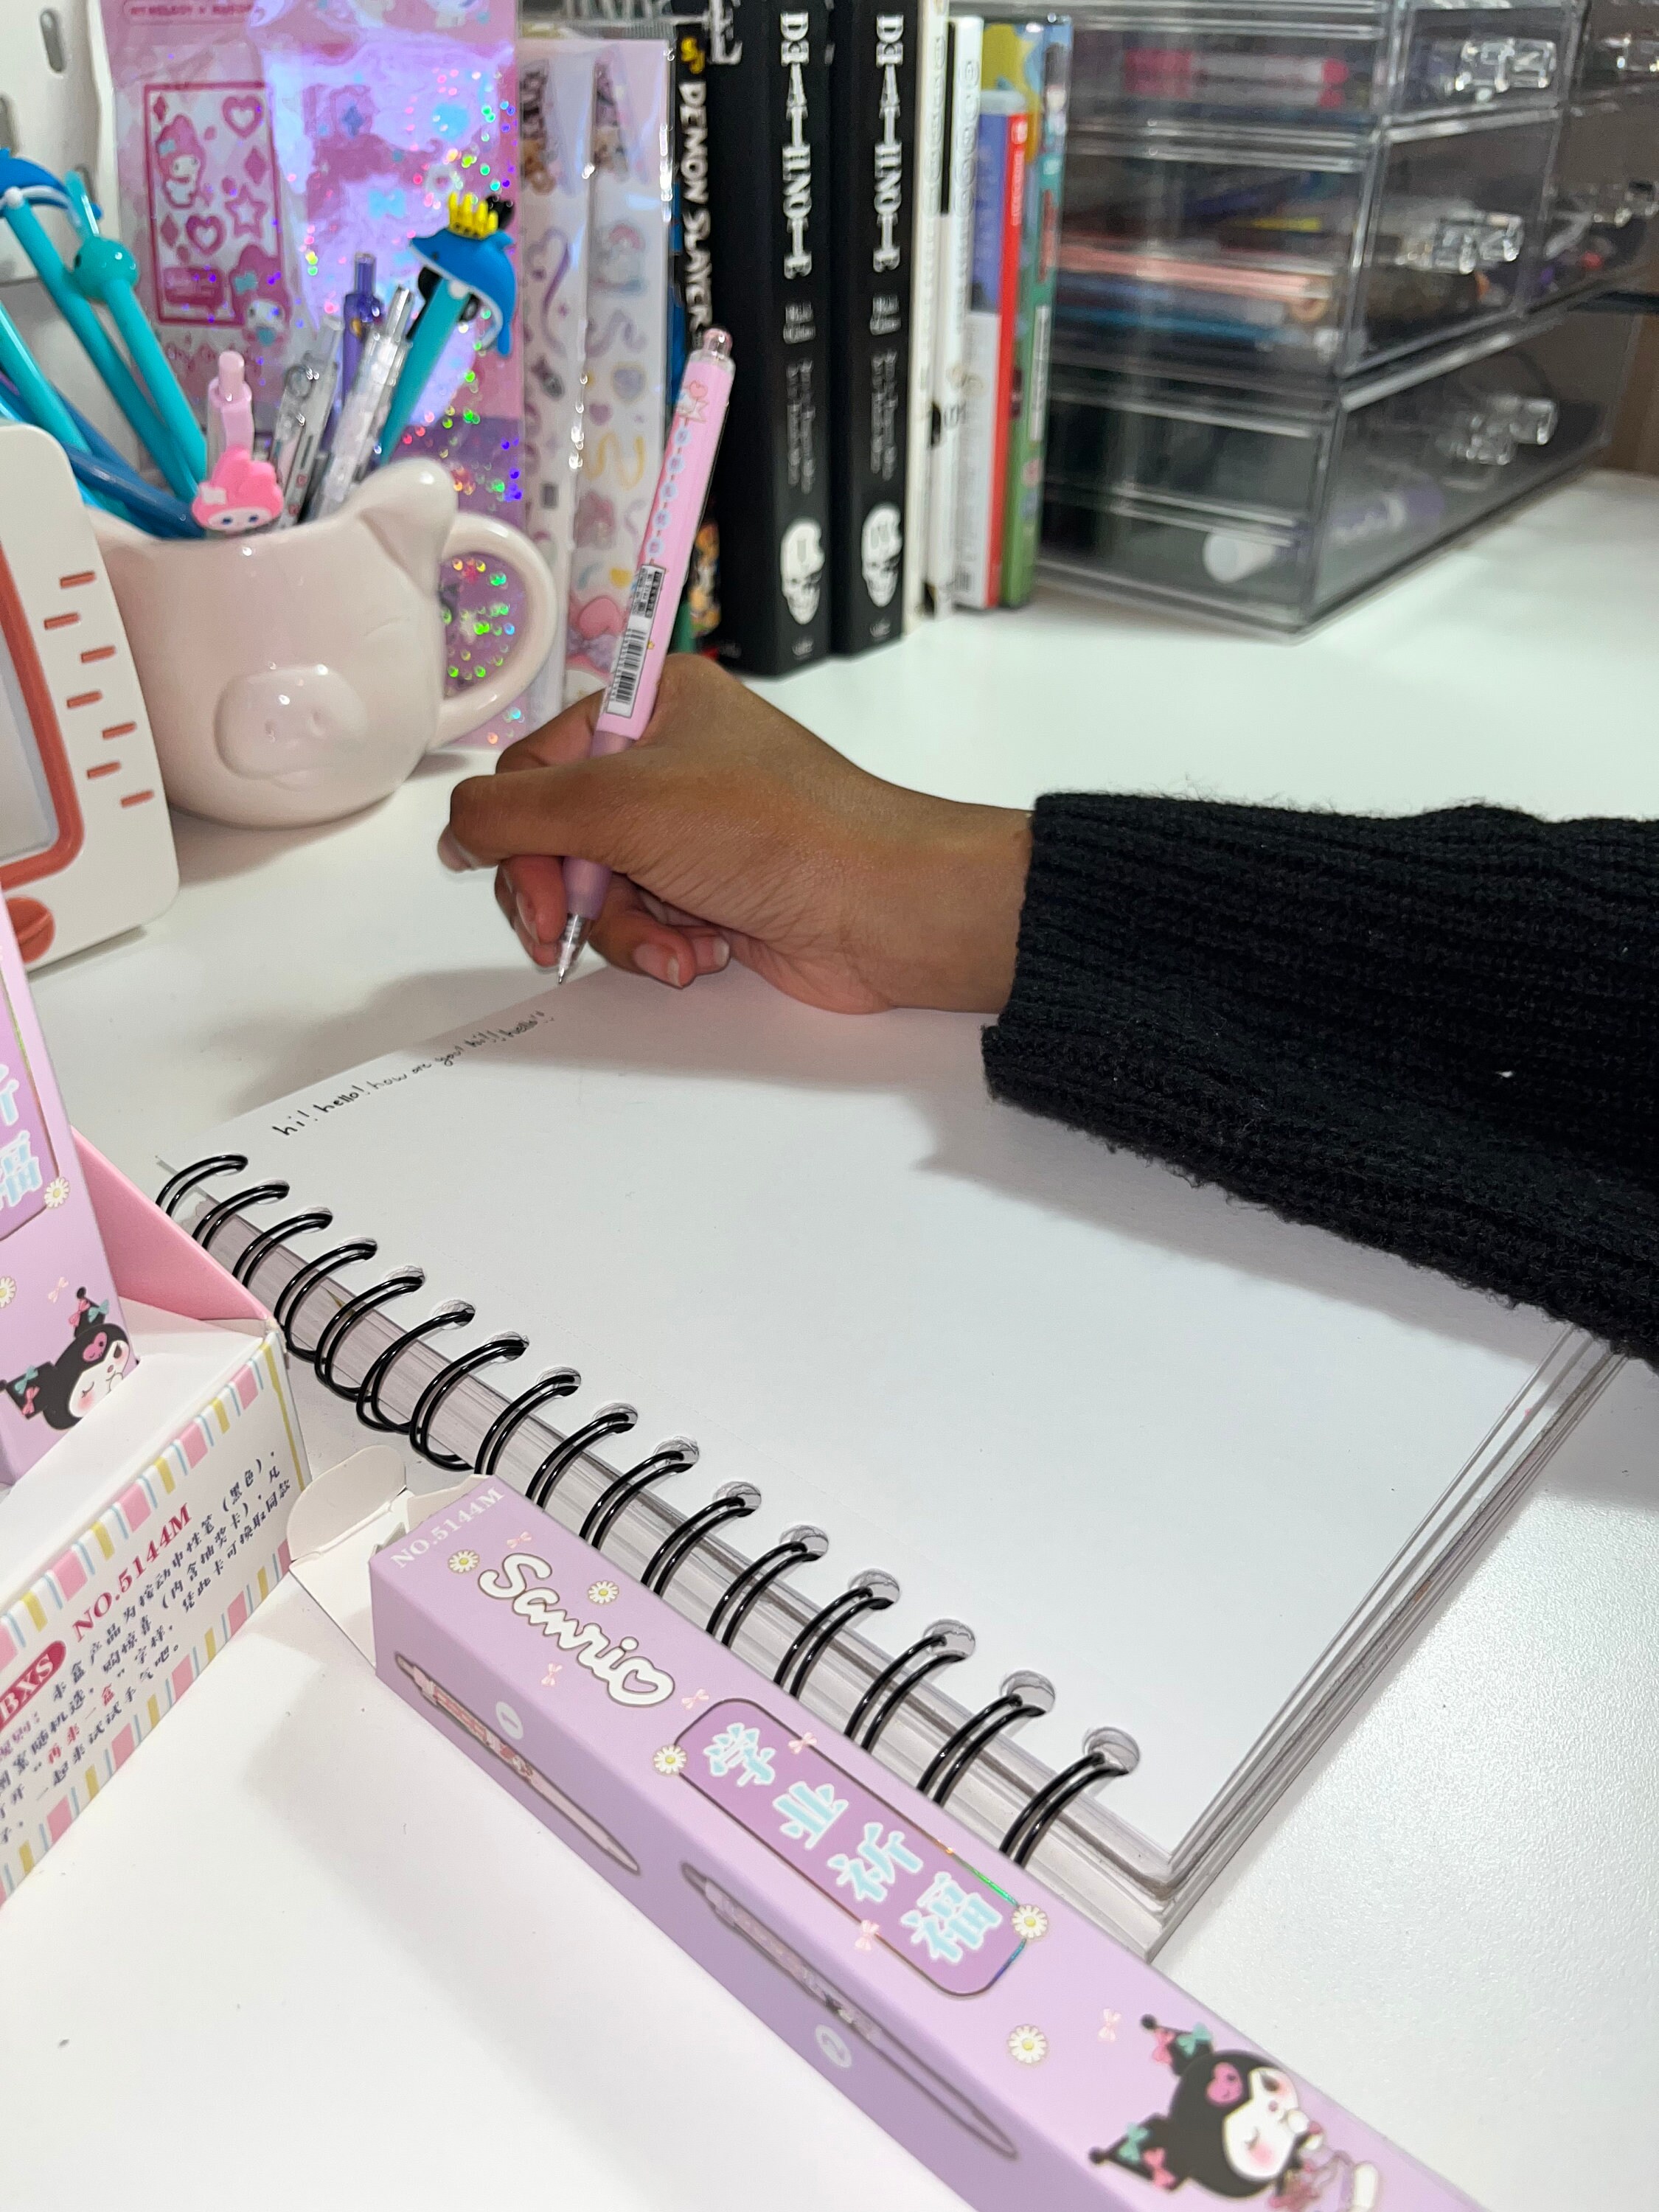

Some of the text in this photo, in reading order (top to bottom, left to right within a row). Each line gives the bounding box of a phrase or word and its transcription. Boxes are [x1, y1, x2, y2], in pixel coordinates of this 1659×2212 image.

[781, 12, 811, 171] DEATH
[876, 14, 904, 170] DEATH
[678, 81, 713, 332] DEMON SLAYER
[782, 169, 812, 279] NOTE
[874, 167, 902, 272] NOTE
[271, 1104, 318, 1136] hi!
[313, 1085, 371, 1113] hello!
[366, 1073, 408, 1090] how
[71, 1502, 192, 1643] NO.5144M
[390, 1486, 505, 1569] NO.5144M
[478, 1552, 675, 1707] Sanrio
[703, 1722, 1003, 1964] 学业祈福
